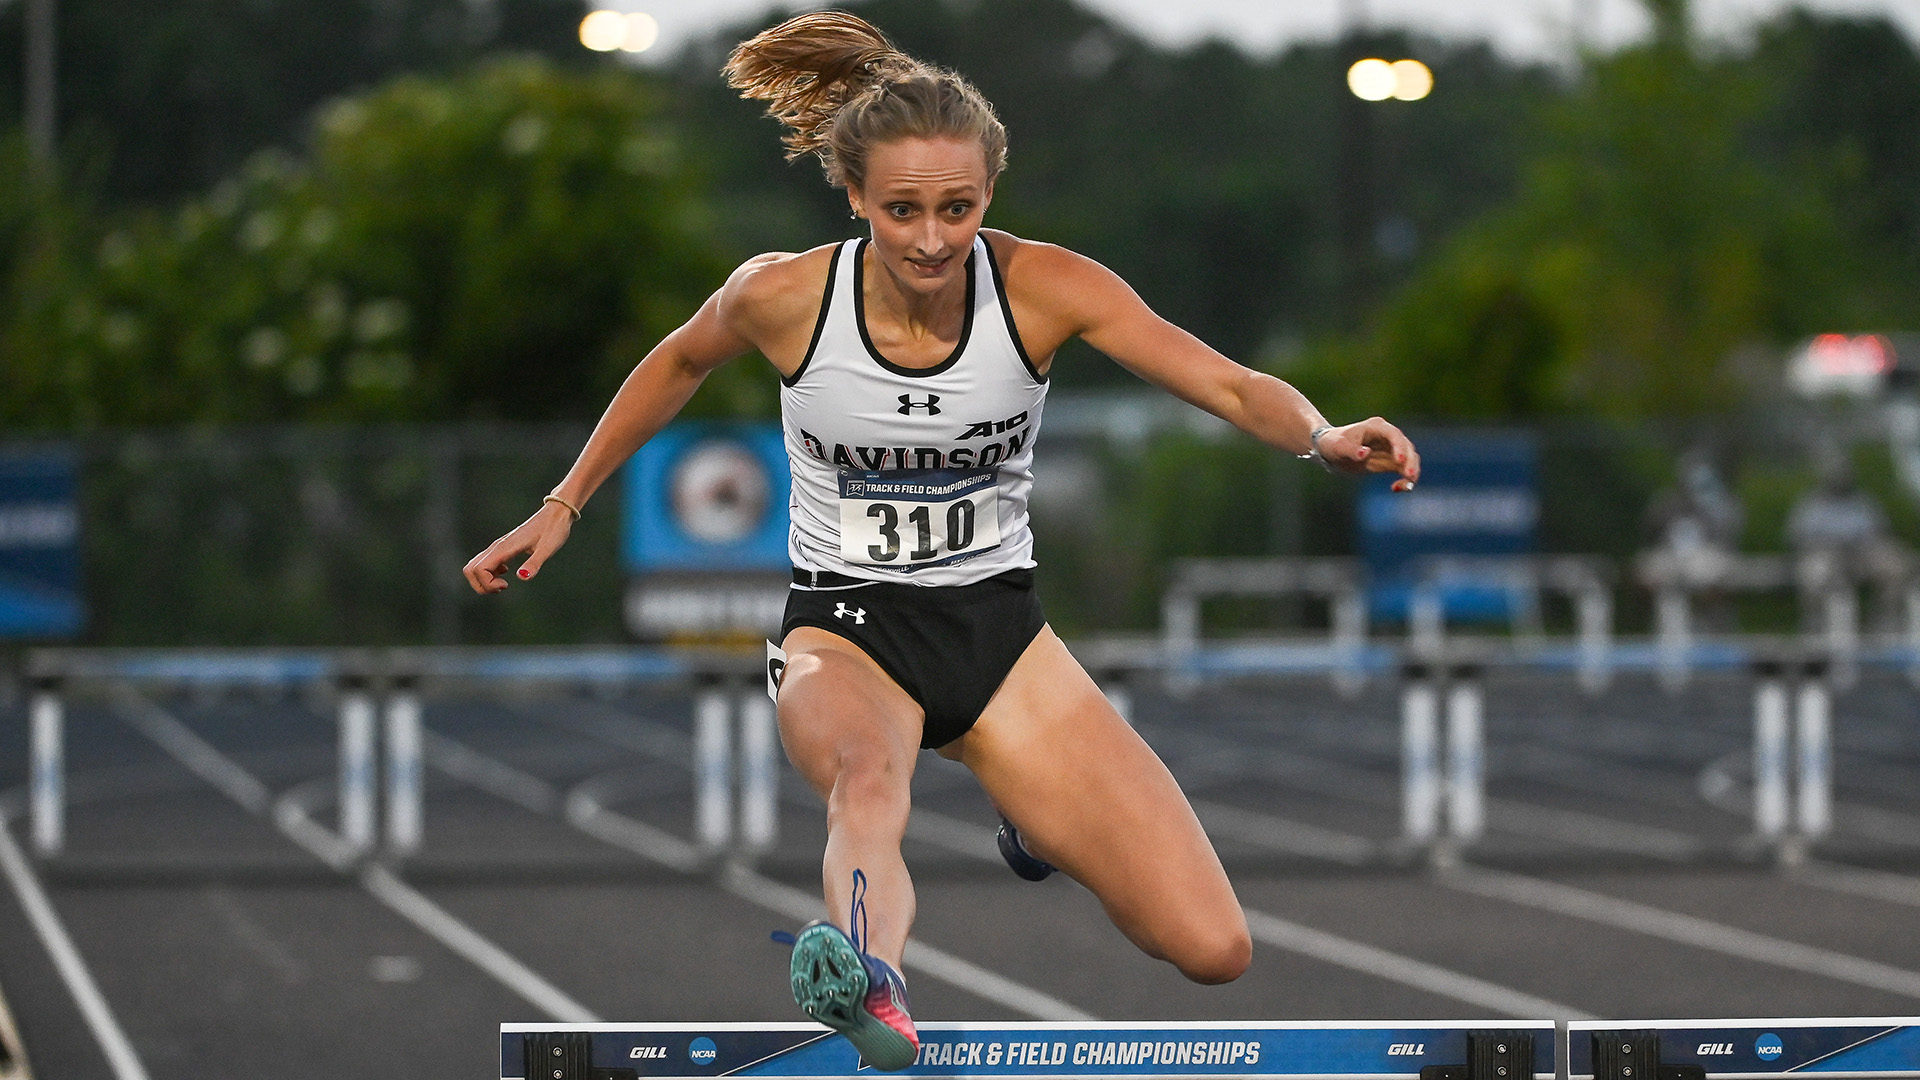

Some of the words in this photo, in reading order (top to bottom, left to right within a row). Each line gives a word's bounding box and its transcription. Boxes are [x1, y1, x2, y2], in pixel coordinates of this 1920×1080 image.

[954, 411, 1028, 440] A10
[800, 425, 1032, 470] DAVIDSON
[865, 483, 893, 493] TRACK
[893, 484, 901, 493] &
[901, 485, 923, 494] FIELD
[926, 473, 992, 495] CHAMPIONSHIPS
[866, 499, 975, 562] 310
[629, 1046, 667, 1059] GILL
[691, 1050, 716, 1058] NCAA
[913, 1042, 985, 1066] TRACK
[986, 1042, 1004, 1066] &
[1006, 1042, 1068, 1066] FIELD
[1072, 1041, 1261, 1065] CHAMPIONSHIPS
[1387, 1043, 1425, 1056] GILL
[1696, 1043, 1734, 1055] GILL
[1757, 1046, 1782, 1055] NCAA
